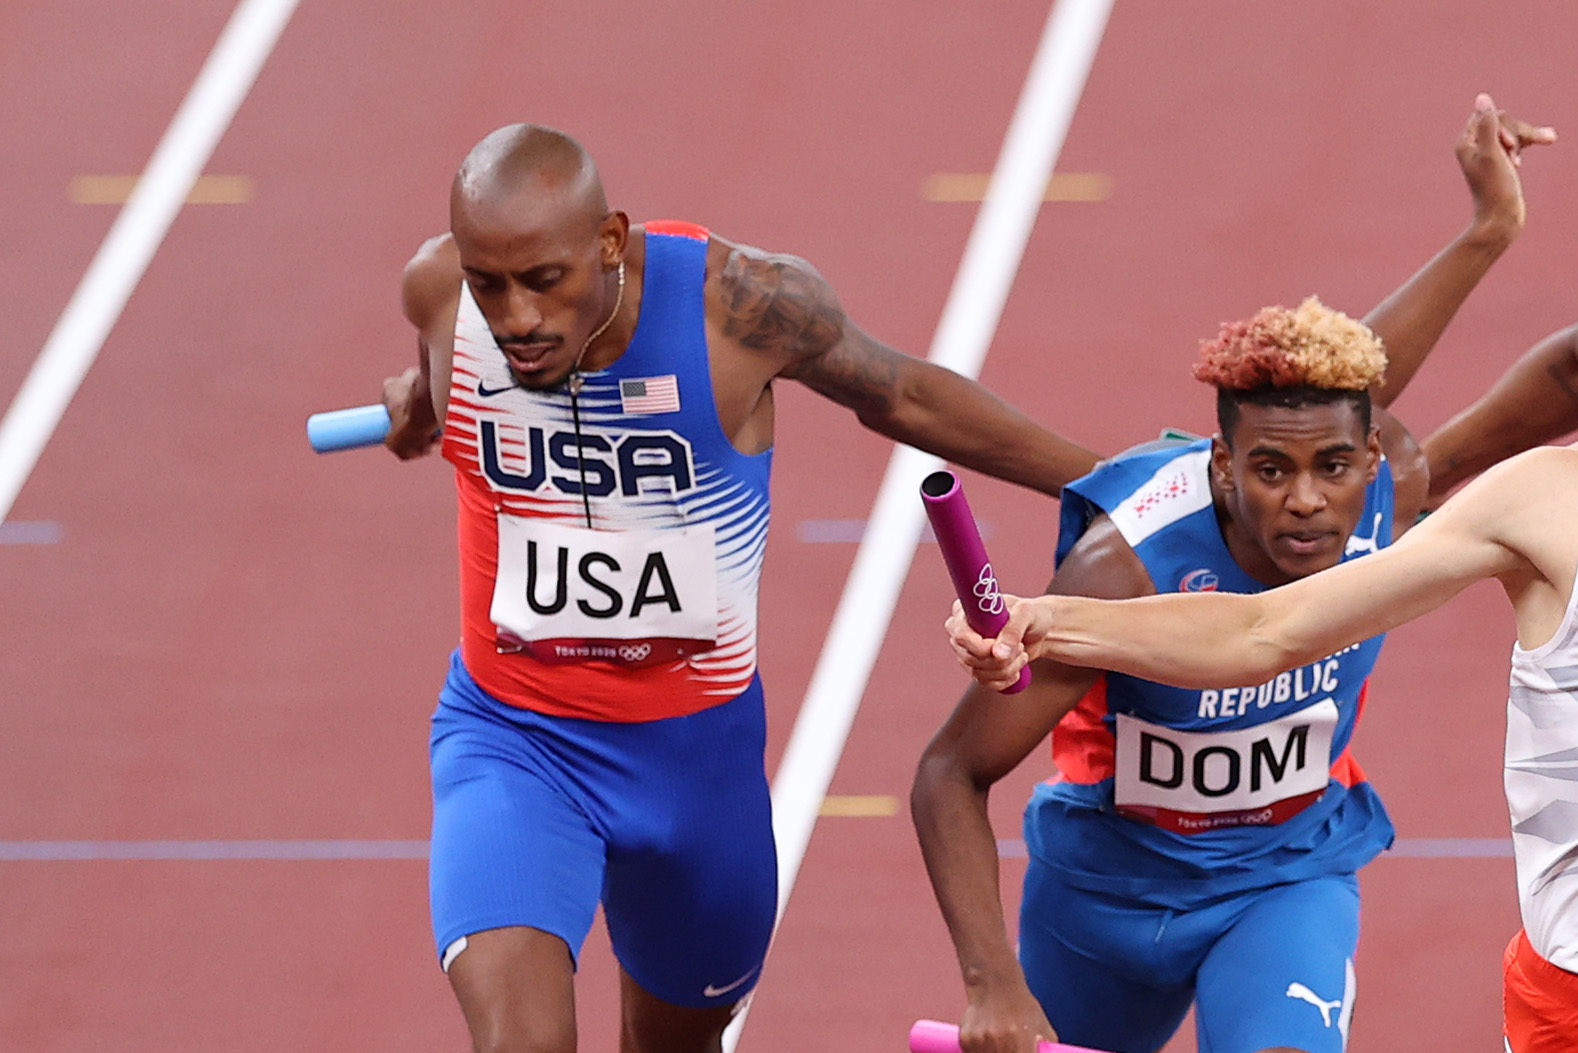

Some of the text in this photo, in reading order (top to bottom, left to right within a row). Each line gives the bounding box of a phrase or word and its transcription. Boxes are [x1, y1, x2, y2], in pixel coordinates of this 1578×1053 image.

[479, 419, 693, 498] USA
[526, 539, 682, 619] USA
[555, 645, 590, 657] TOKYO
[1198, 659, 1340, 719] REPUBLIC
[1139, 724, 1311, 797] DOM
